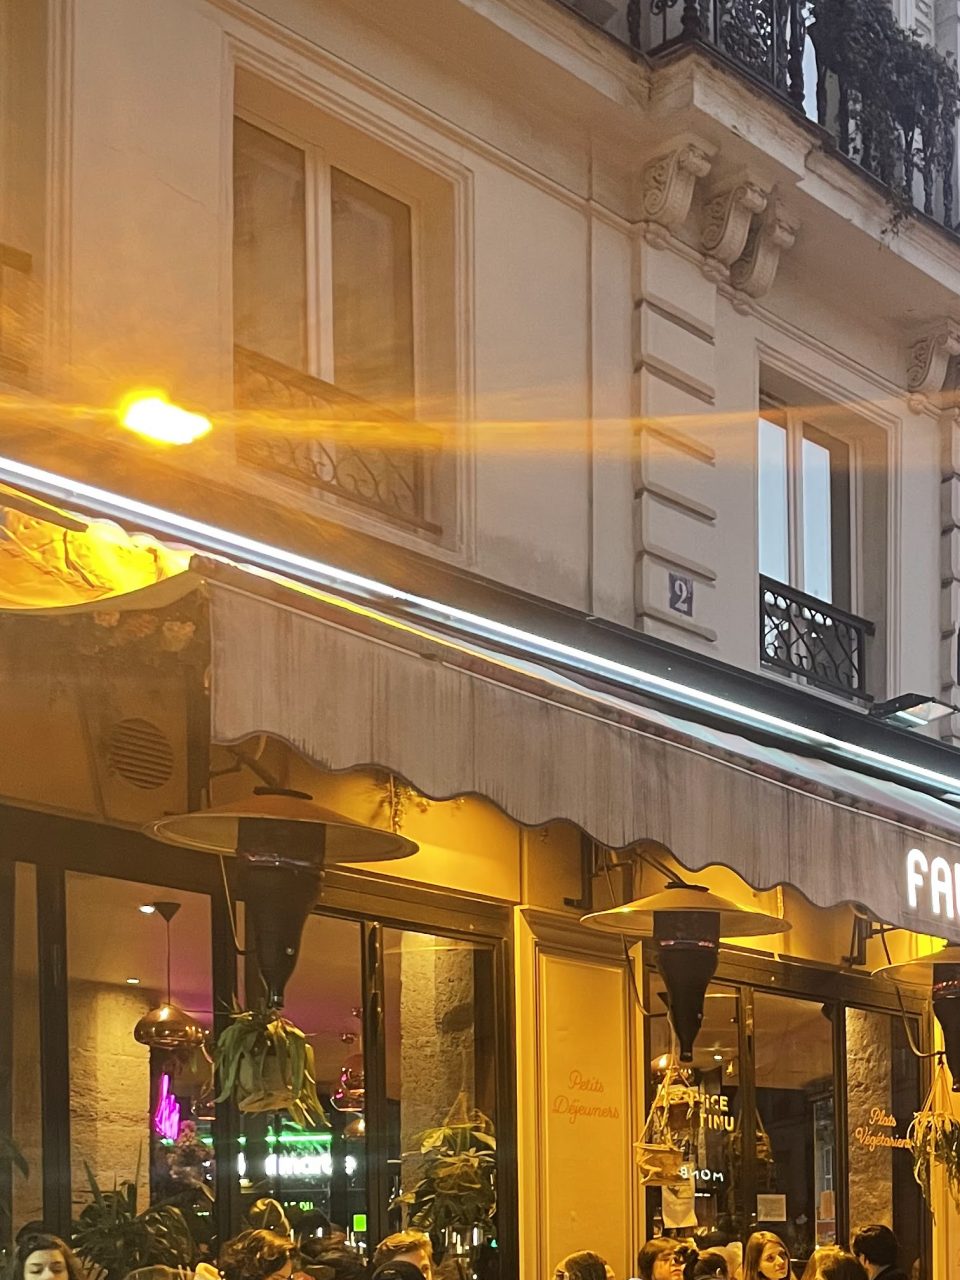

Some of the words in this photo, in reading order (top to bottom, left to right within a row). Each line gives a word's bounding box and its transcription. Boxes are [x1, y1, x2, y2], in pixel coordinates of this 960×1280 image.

[674, 580, 688, 611] 2
[568, 1070, 604, 1093] Petits
[552, 1095, 619, 1125] Déjeuners
[700, 1112, 734, 1131] TINU
[869, 1107, 897, 1127] Plats
[855, 1126, 912, 1151] Végétarien
